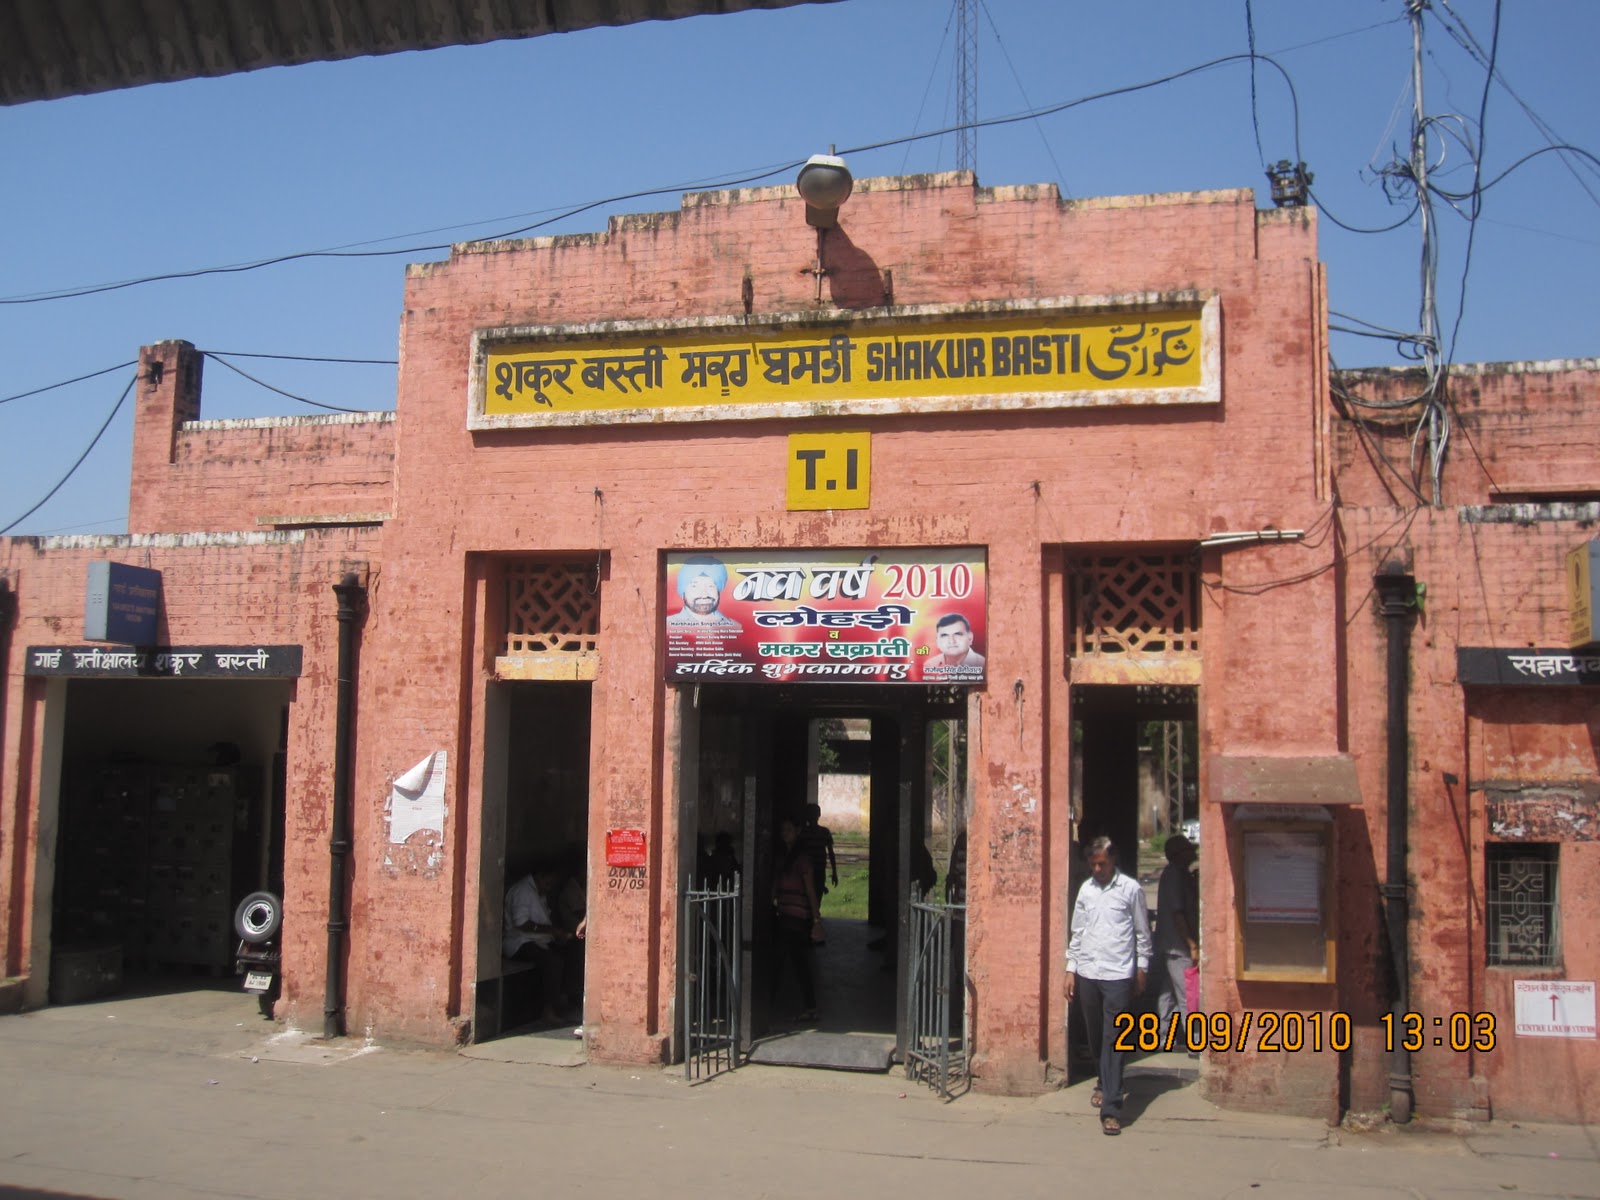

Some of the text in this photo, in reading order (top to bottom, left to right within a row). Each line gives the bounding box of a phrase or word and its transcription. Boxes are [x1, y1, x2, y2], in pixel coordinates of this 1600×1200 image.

[866, 333, 1080, 382] SHAKUR BASTI
[495, 345, 668, 407] शकूर बस्ती
[796, 449, 858, 490] T.I
[732, 554, 971, 600] नव वर्ष 2010
[754, 605, 916, 630] लोहड़ी
[35, 648, 269, 675] गार्ड प्रतीक्षालय शकूर बस्ती
[759, 643, 821, 656] मकर
[916, 645, 929, 655] की
[676, 659, 756, 675] हार्दिक
